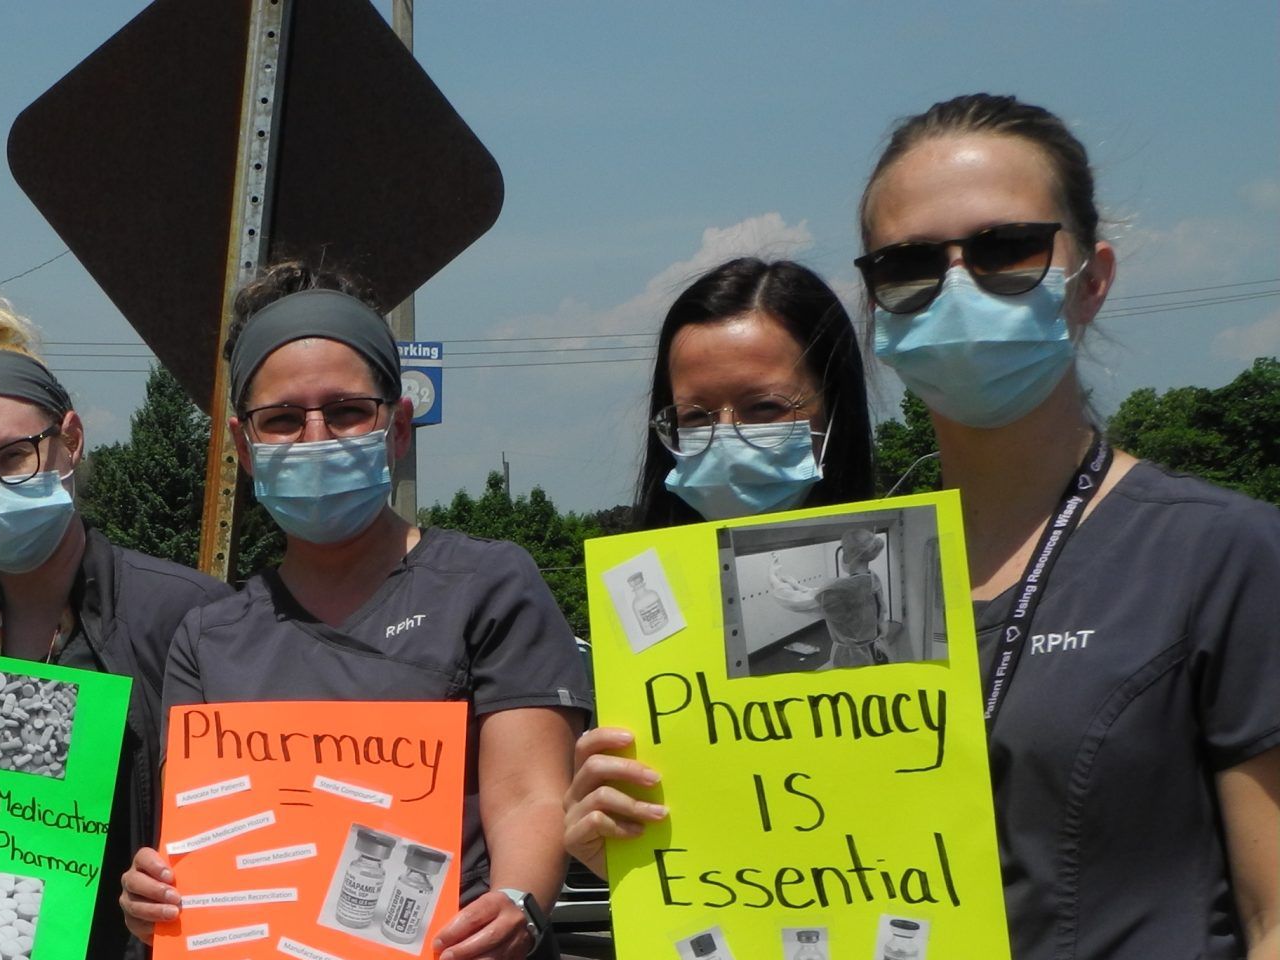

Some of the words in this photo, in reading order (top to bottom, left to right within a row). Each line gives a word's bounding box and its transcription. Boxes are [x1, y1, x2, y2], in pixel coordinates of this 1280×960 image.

[398, 344, 439, 359] rking
[984, 679, 1003, 719] Patient
[997, 651, 1013, 678] First
[1014, 584, 1038, 618] Using
[1027, 530, 1063, 584] Resources
[1054, 495, 1083, 529] Wisely
[385, 614, 427, 639] RPhT
[1031, 630, 1095, 655] RPhT
[644, 671, 946, 773] Pharmacy
[182, 710, 443, 802] Pharmacy
[181, 789, 209, 802] Advocate
[210, 786, 219, 796] for
[220, 781, 246, 793] Patients
[320, 780, 341, 792] Sterile
[186, 834, 212, 847] Possible
[212, 823, 247, 838] Medication
[247, 816, 270, 828] History
[242, 856, 271, 866] Dispense
[272, 848, 312, 860] Medications
[653, 831, 960, 909] Essential
[182, 898, 210, 906] ischarge
[211, 894, 247, 904] Medication
[248, 891, 293, 902] Reconciliation
[385, 889, 403, 926] Naloxone
[192, 936, 228, 946] Medication
[228, 928, 265, 941] Counselling
[284, 942, 324, 960] Manufacture
